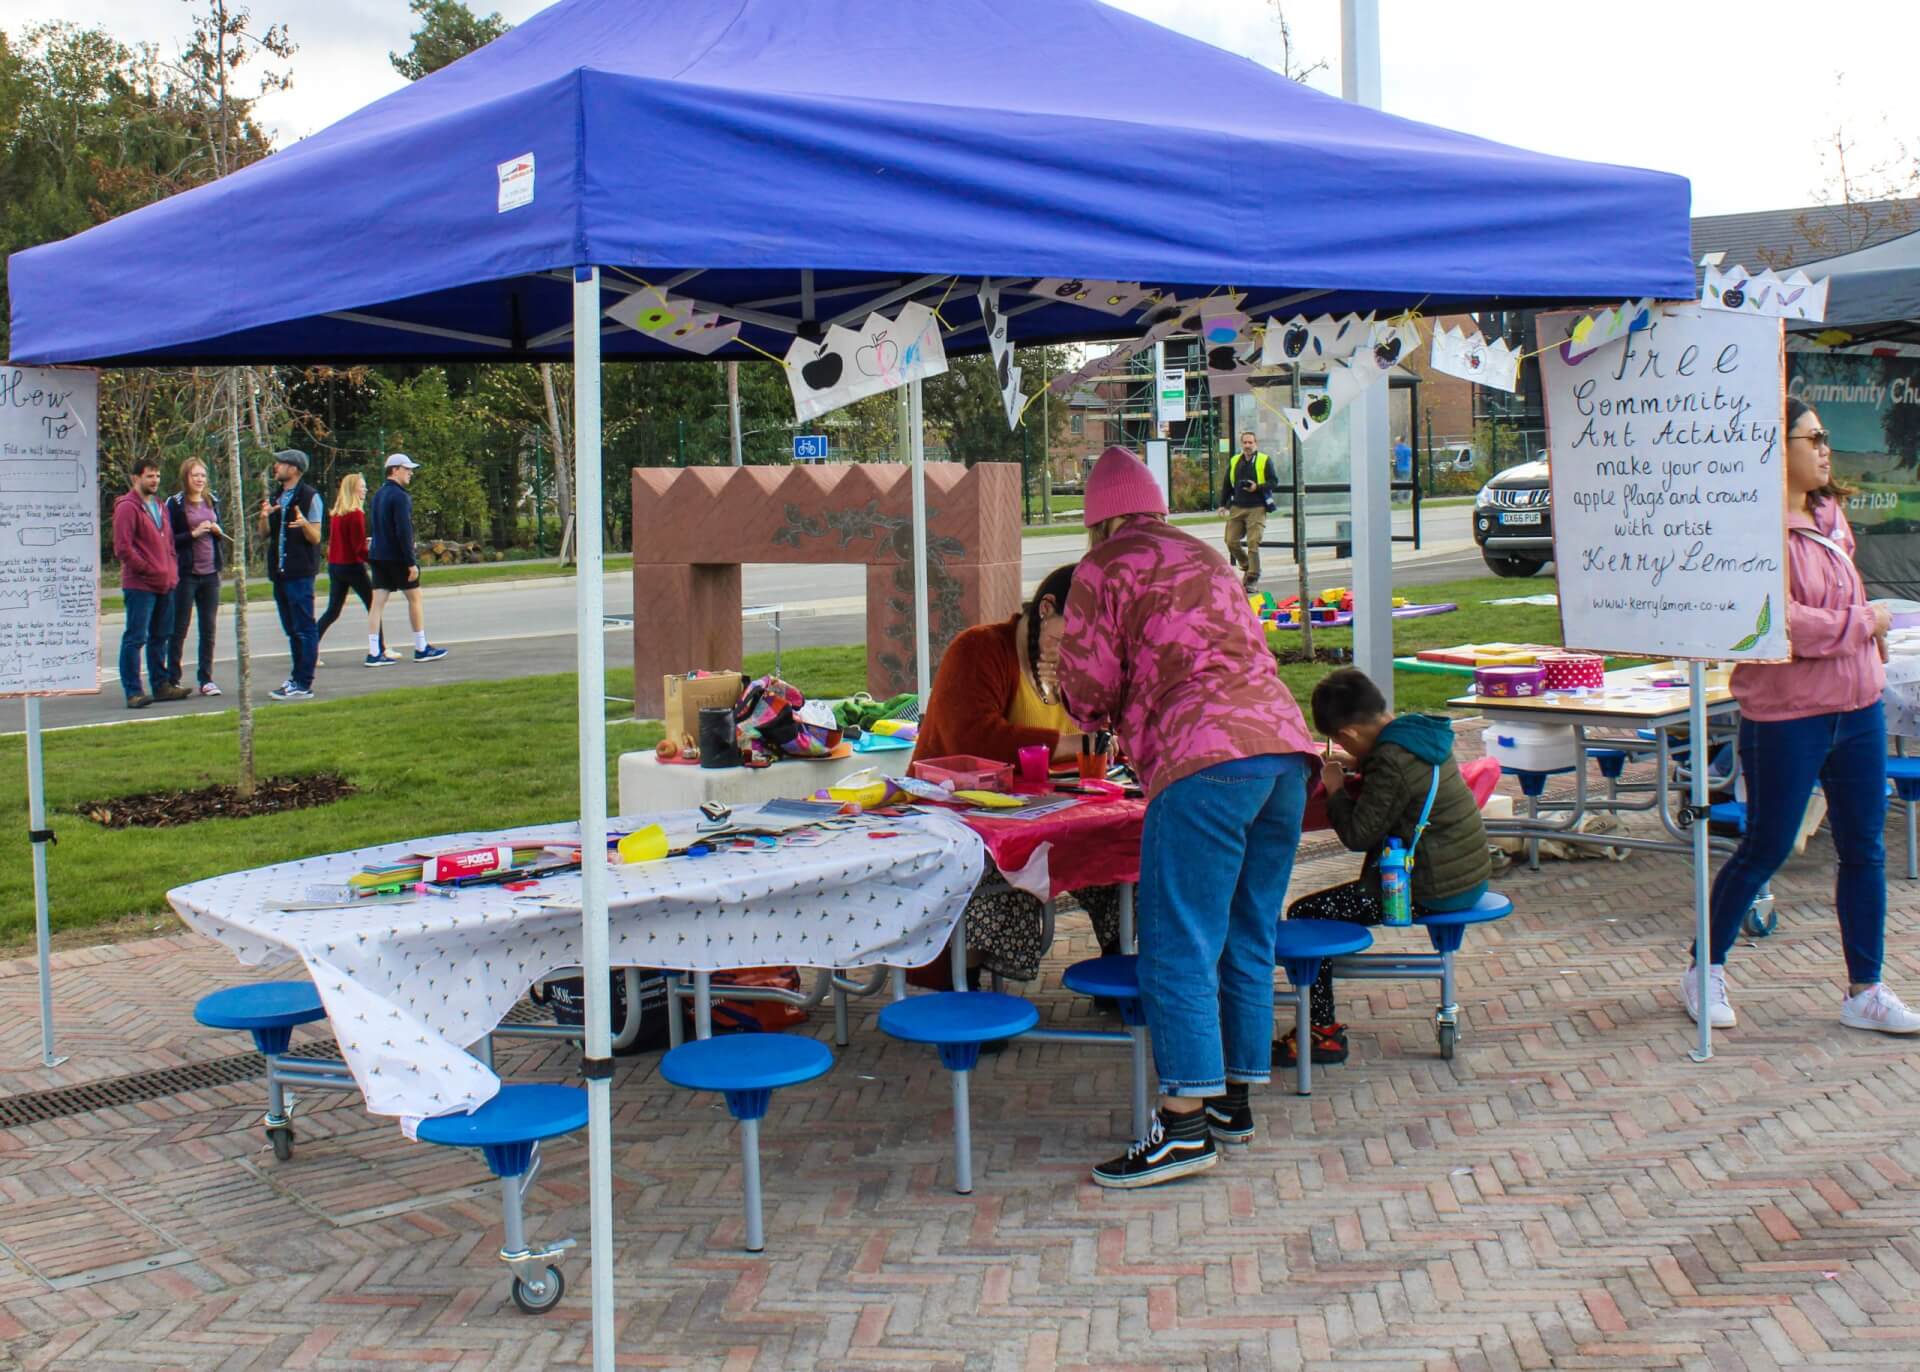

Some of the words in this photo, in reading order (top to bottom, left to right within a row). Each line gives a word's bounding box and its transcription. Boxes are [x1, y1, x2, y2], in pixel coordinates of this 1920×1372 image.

[1611, 321, 1739, 381] Free
[0, 370, 73, 408] How
[1573, 378, 1752, 430] Community
[1787, 375, 1887, 410] Community
[42, 412, 77, 440] To
[1572, 419, 1635, 449] Art
[1652, 420, 1777, 464] Activity
[1596, 457, 1653, 476] make
[1661, 460, 1700, 491] your
[1707, 460, 1745, 475] own
[1573, 485, 1615, 512] apple
[1622, 483, 1664, 519] flags
[1669, 485, 1702, 505] and
[1707, 489, 1759, 504] crowns
[1850, 496, 1867, 510] at
[1614, 519, 1654, 537] with
[1664, 519, 1713, 537] artist
[1582, 547, 1675, 587] Kerry
[1678, 540, 1777, 572] Lemon
